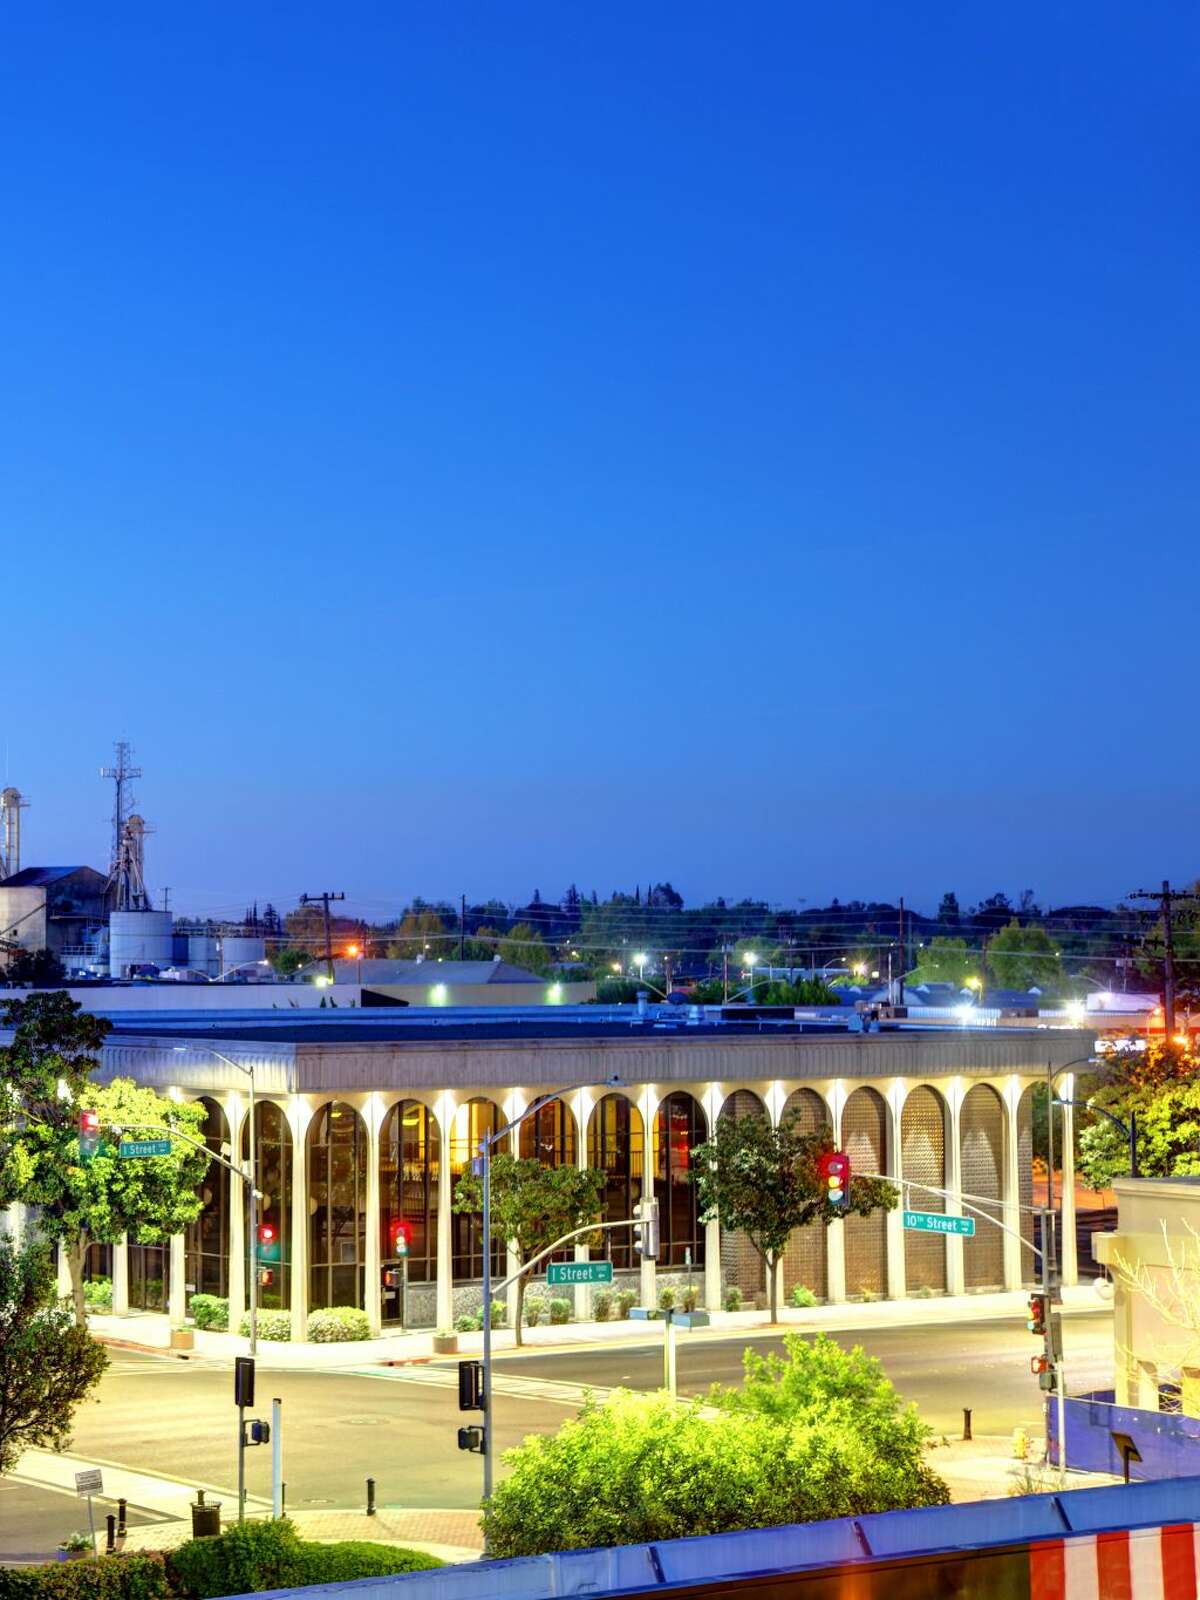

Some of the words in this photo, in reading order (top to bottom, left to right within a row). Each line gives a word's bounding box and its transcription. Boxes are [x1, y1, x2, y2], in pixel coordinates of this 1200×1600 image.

[129, 1144, 156, 1155] Street
[926, 1216, 957, 1231] Street
[560, 1266, 593, 1281] Street
